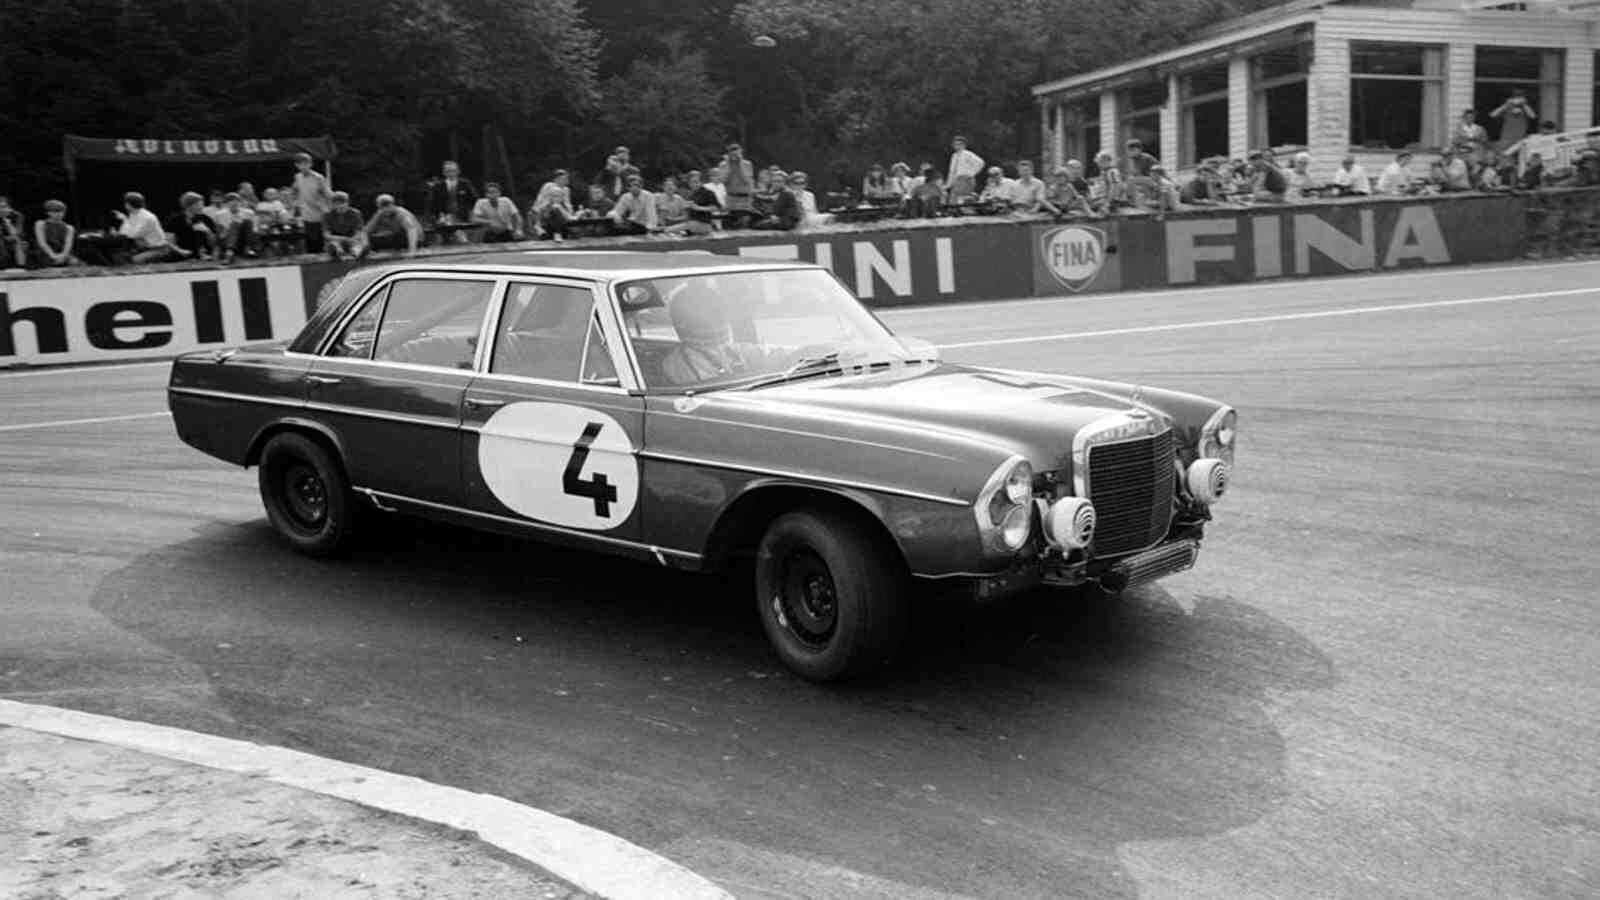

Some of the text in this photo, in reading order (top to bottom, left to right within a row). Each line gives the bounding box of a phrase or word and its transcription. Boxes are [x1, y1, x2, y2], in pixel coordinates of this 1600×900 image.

[739, 237, 956, 299] INI
[1054, 241, 1097, 267] FINA
[1165, 206, 1450, 284] FINA
[0, 278, 274, 356] hell
[562, 421, 618, 519] 4
